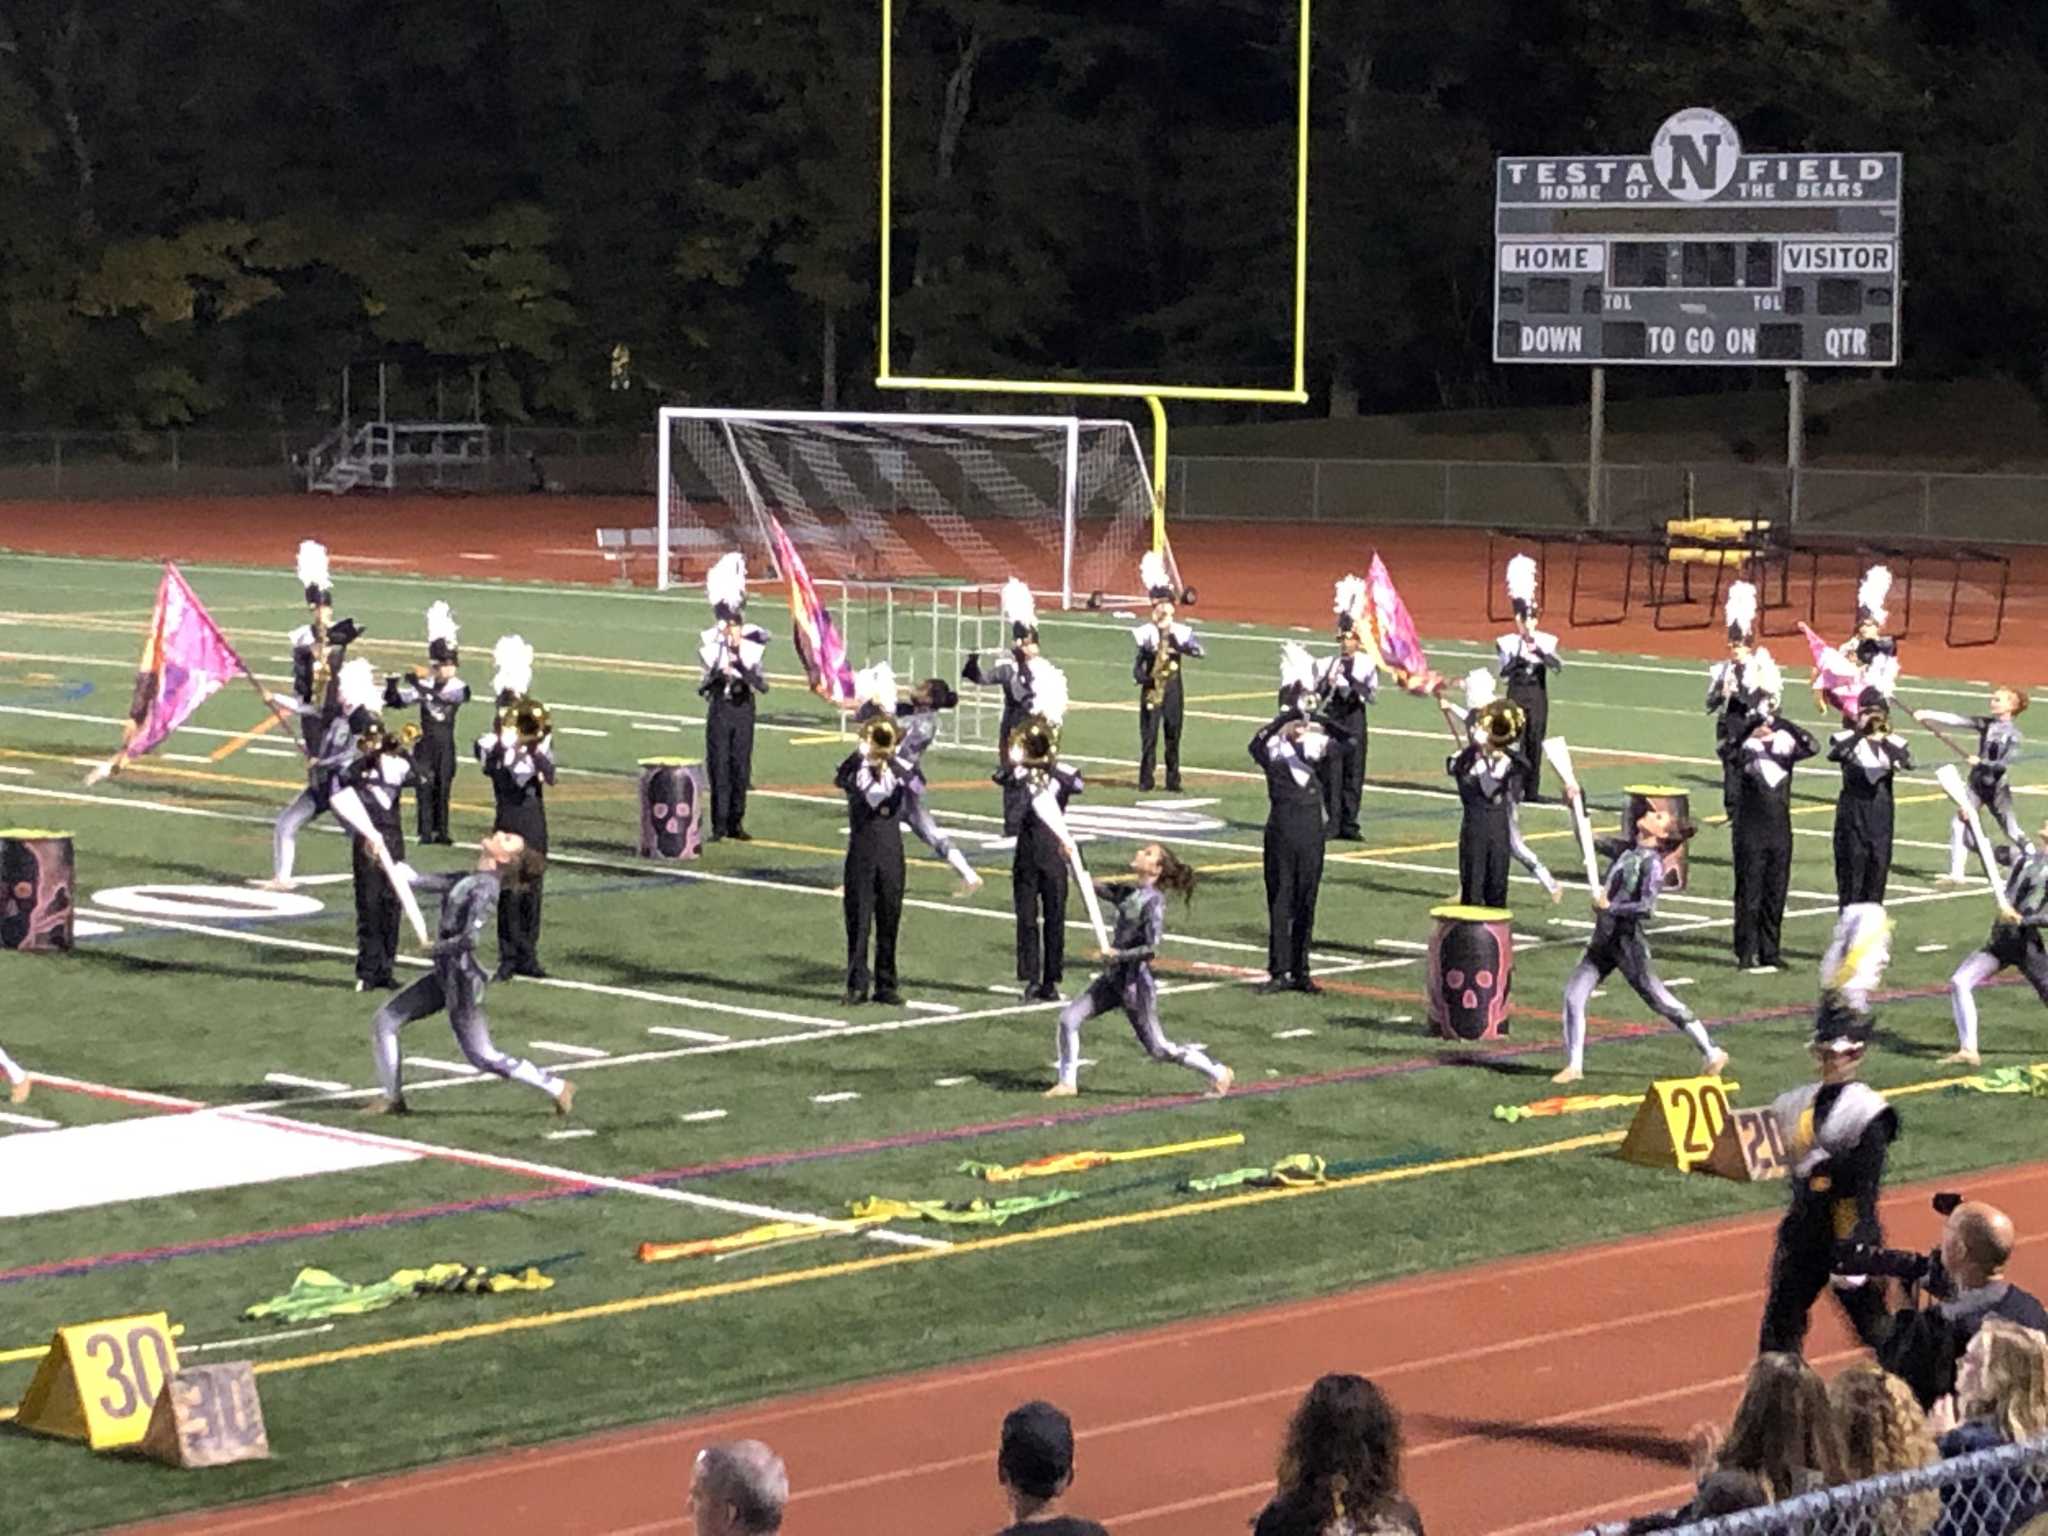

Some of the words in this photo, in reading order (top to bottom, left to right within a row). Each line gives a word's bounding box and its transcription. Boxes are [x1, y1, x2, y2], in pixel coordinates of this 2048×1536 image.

[1507, 162, 1648, 184] TESTA
[1749, 159, 1884, 181] FIELD
[1668, 134, 1721, 189] N
[1540, 185, 1602, 200] HOME
[1626, 184, 1653, 199] OF
[1738, 183, 1776, 198] THE
[1796, 182, 1864, 198] BEARS
[1515, 248, 1589, 268] HOME
[1788, 247, 1888, 268] VISITOR
[1521, 326, 1583, 352] DOWN
[1648, 326, 1676, 354] TO
[1685, 327, 1716, 354] GO
[1726, 327, 1757, 354] ON
[1825, 327, 1868, 358] QTR
[1671, 1085, 1728, 1153] 20
[86, 1327, 174, 1419] 30
